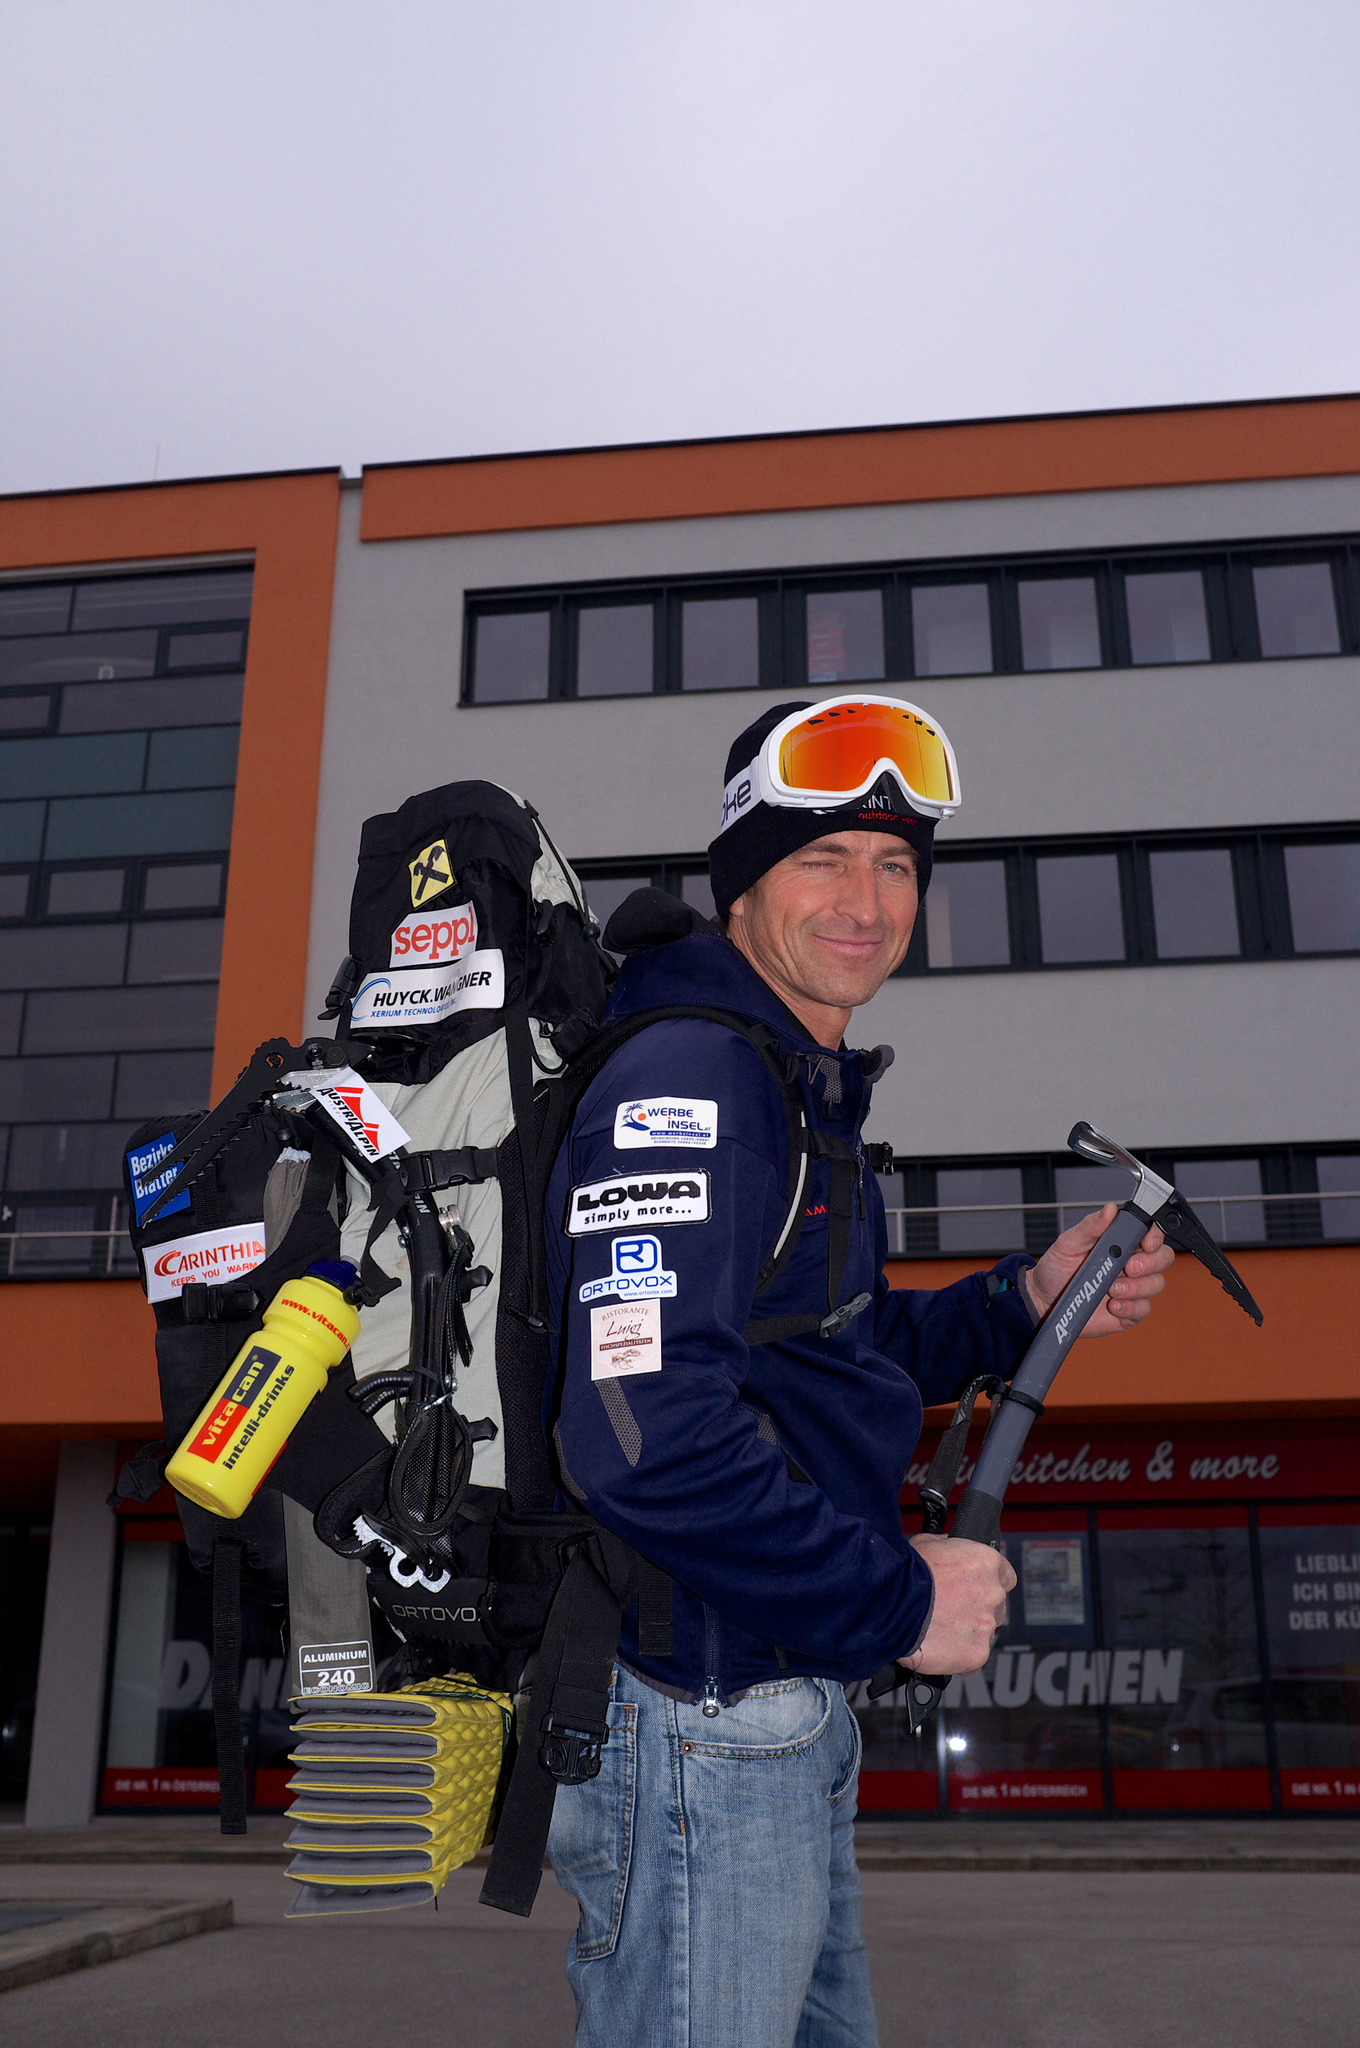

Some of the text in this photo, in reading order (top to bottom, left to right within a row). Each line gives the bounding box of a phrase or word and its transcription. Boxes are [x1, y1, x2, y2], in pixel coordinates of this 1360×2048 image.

[394, 906, 476, 960] seppl
[370, 1009, 402, 1018] XERIUM
[317, 1087, 379, 1156] AUSTRIALPIN
[647, 1107, 694, 1118] WERBE
[577, 1180, 701, 1211] LOWA
[584, 1206, 692, 1224] simply more...
[154, 1240, 266, 1277] CARINTHIA
[171, 1261, 259, 1287] KEEPS YOU WARM
[582, 1275, 672, 1299] ORTOVOX
[623, 1289, 673, 1297] www.ortovox.com
[1054, 1257, 1114, 1345] AUSTRIALPIN
[601, 1307, 650, 1321] RISTORANTE
[606, 1319, 644, 1341] Luigi
[201, 1361, 264, 1446] vitacan
[222, 1364, 295, 1470] intelli-drinks
[1145, 1440, 1173, 1482] &
[1190, 1453, 1280, 1481] more
[1295, 1553, 1360, 1574] LIEBLI
[1292, 1582, 1328, 1602] ICH
[392, 1604, 481, 1622] ORTOVO
[1288, 1610, 1329, 1631] DER
[303, 1650, 367, 1663] ALUMINIUM
[303, 1682, 370, 1694] ECONOMIC
[317, 1669, 356, 1687] 240
